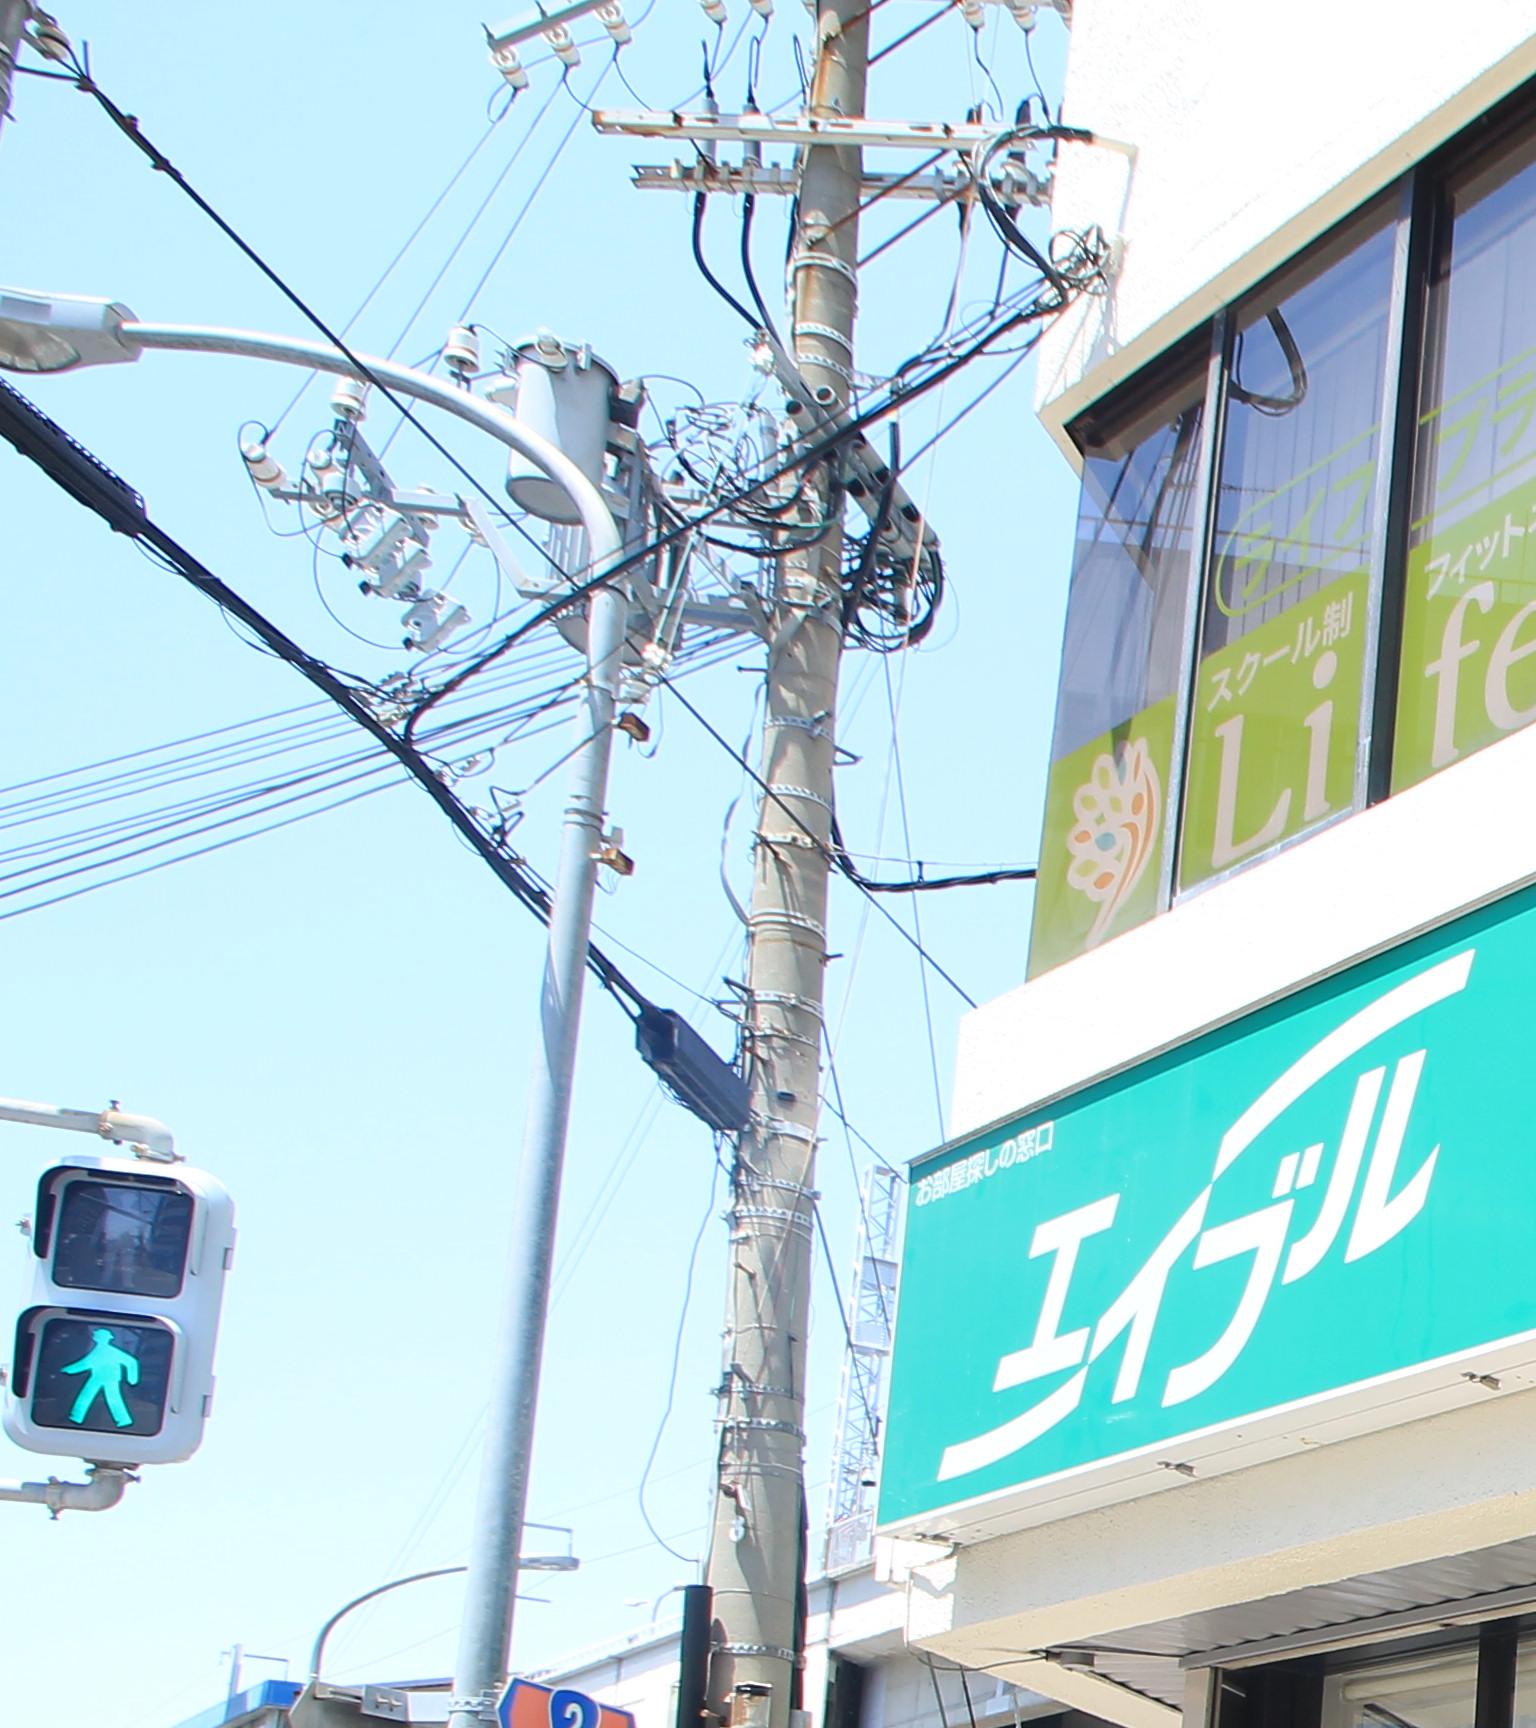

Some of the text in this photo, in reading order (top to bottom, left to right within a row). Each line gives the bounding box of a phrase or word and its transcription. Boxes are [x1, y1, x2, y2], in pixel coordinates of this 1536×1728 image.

[1207, 591, 1354, 712] スクール制
[914, 1120, 1056, 1207] お部屋探しの窓口
[936, 948, 1477, 1482] エイブル
